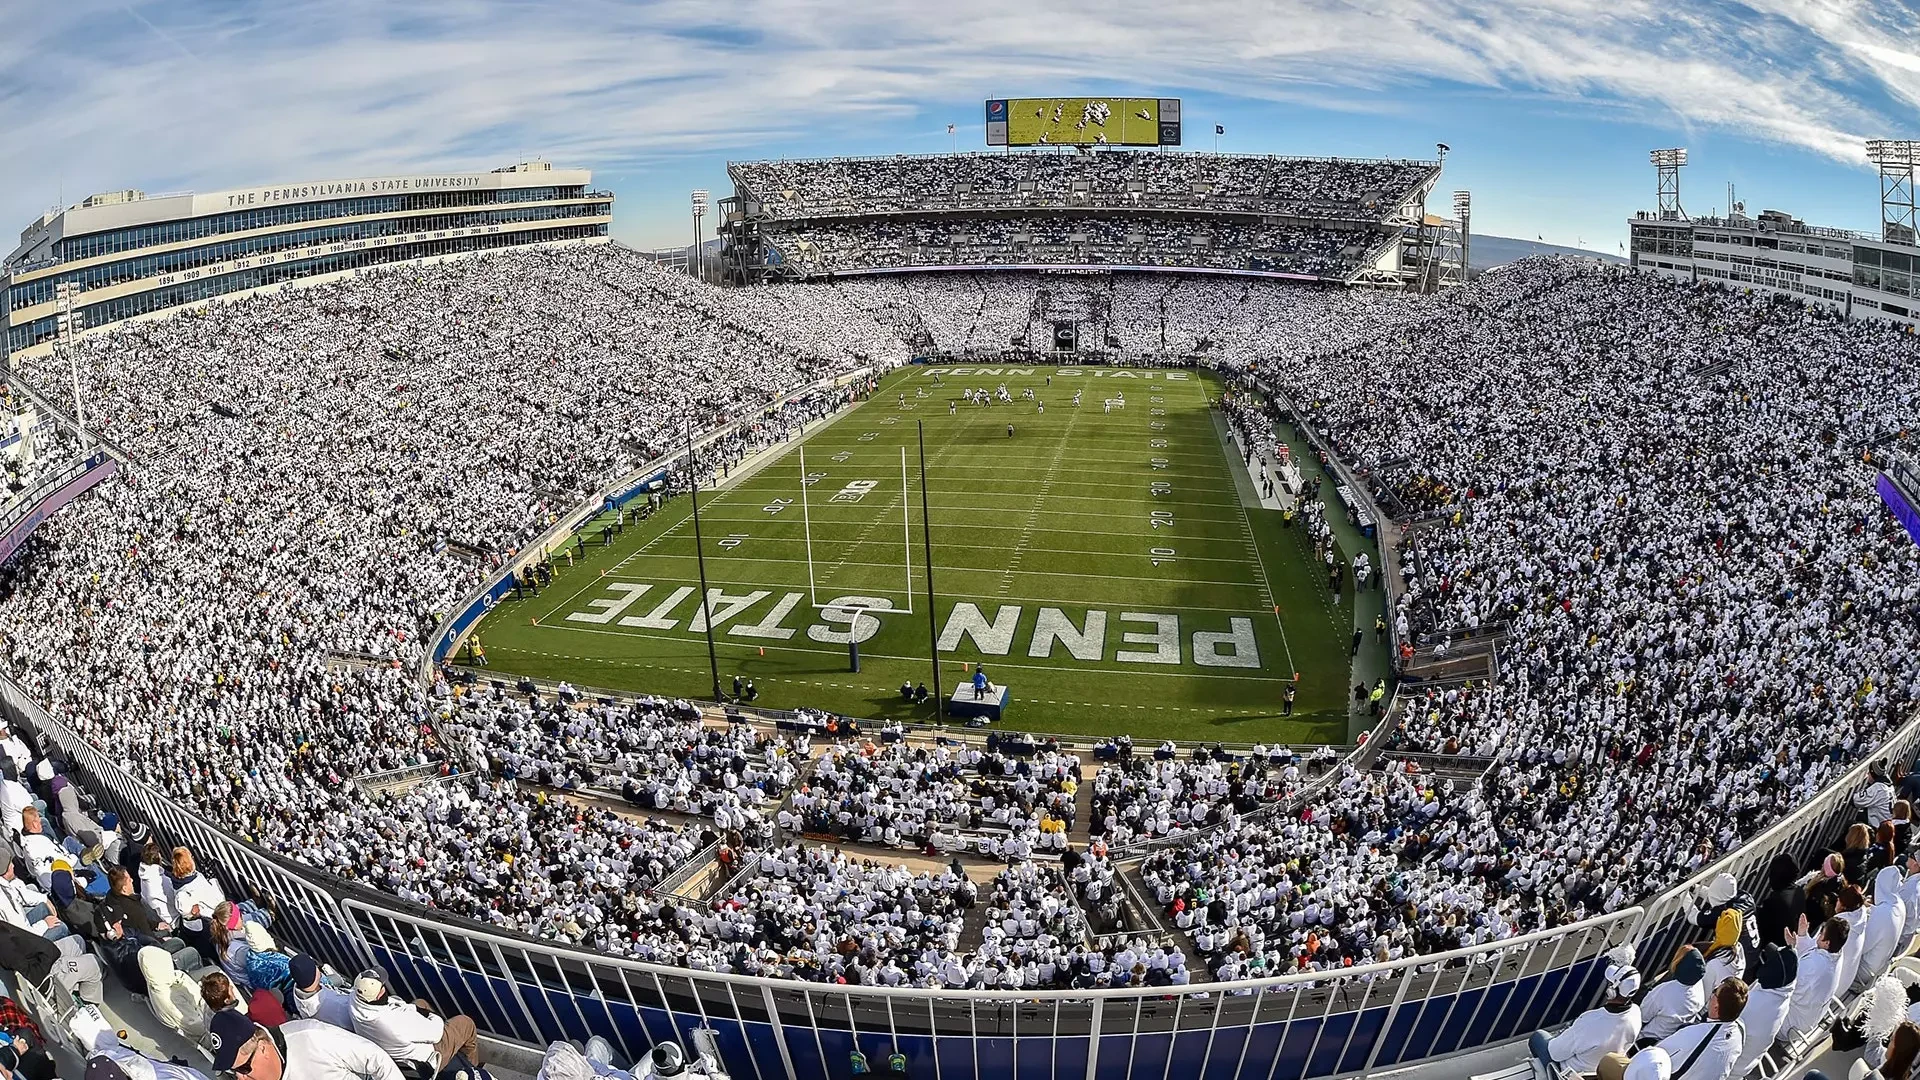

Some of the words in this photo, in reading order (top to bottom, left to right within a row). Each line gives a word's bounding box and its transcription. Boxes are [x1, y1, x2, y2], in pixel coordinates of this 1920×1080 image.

[228, 193, 255, 206] THE
[264, 182, 365, 202] PENNSYLVANIA
[372, 178, 409, 191] STATE
[415, 177, 481, 188] UNIVERSITY
[1722, 219, 1749, 228] STATE
[1781, 223, 1817, 236] NITTANY
[1821, 228, 1849, 239] LIONS
[159, 275, 175, 286] 1894
[183, 270, 200, 281] 1909
[208, 264, 225, 275] 1911
[259, 255, 275, 265] 1920
[283, 251, 299, 260] 1921
[307, 247, 321, 256] 1947
[373, 238, 387, 246] 1973
[1732, 264, 1761, 275] BEAVER
[1764, 269, 1801, 282] STADIUM
[921, 368, 1035, 376] PENN
[1056, 368, 1189, 381] STATE
[1150, 481, 1171, 494] 30
[762, 498, 794, 513] 20
[1150, 510, 1174, 527] 20
[717, 533, 749, 547] 10
[1150, 547, 1176, 562] 10
[565, 582, 894, 644] STATE
[937, 601, 1261, 669] PENN
[68, 961, 79, 973] 20
